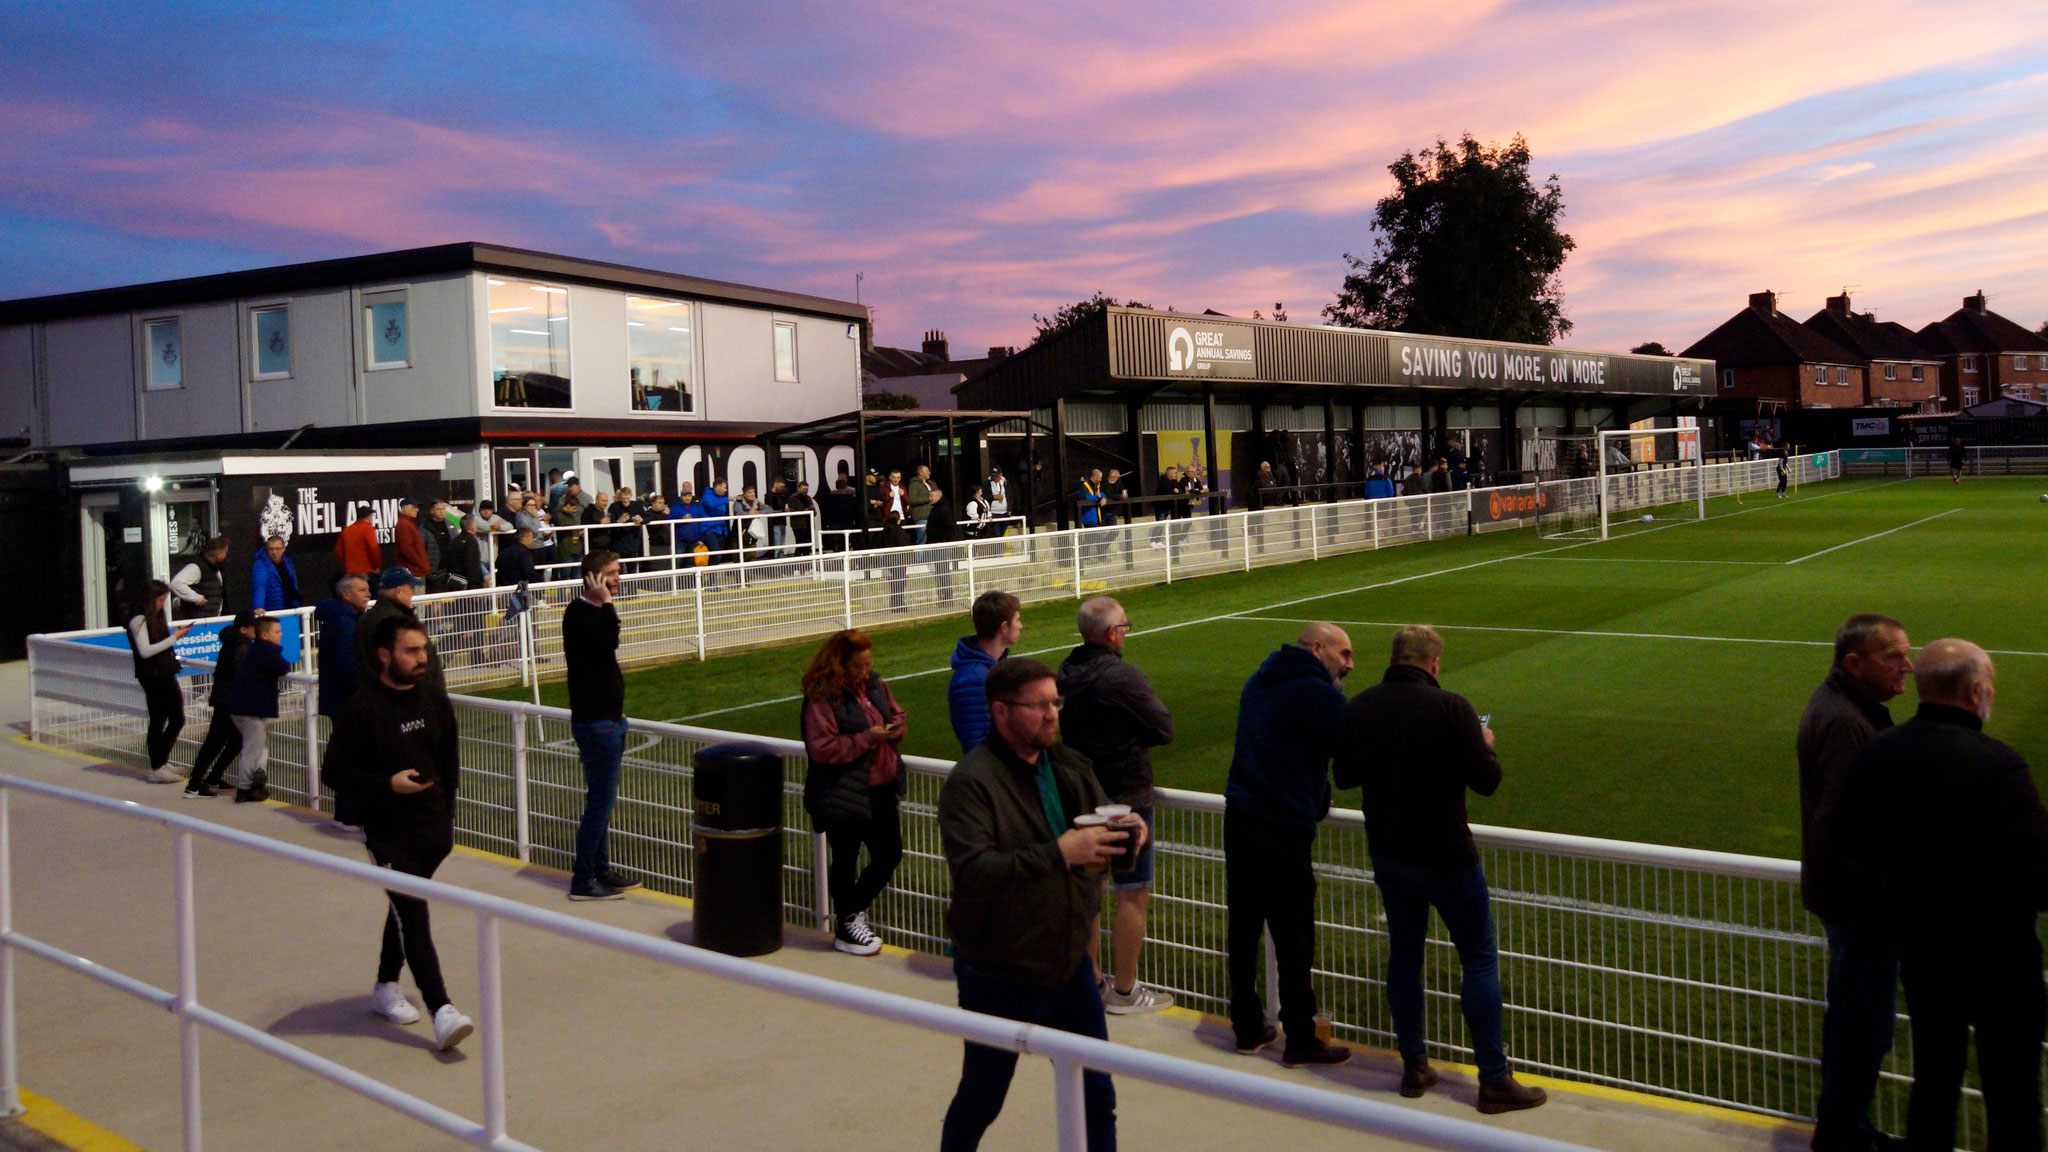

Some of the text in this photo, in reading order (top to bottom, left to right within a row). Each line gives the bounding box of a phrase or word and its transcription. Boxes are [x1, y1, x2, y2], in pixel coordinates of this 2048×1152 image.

[1195, 332, 1223, 346] GREAT
[1196, 347, 1252, 360] ANNUAL SAVINGS
[1196, 362, 1211, 370] GROUP
[1401, 346, 1604, 385] SAVING YOU MORE, ON MORE
[297, 487, 318, 504] THE
[297, 502, 342, 535] NEIL
[168, 520, 179, 555] LADIES
[175, 630, 219, 646] eesside
